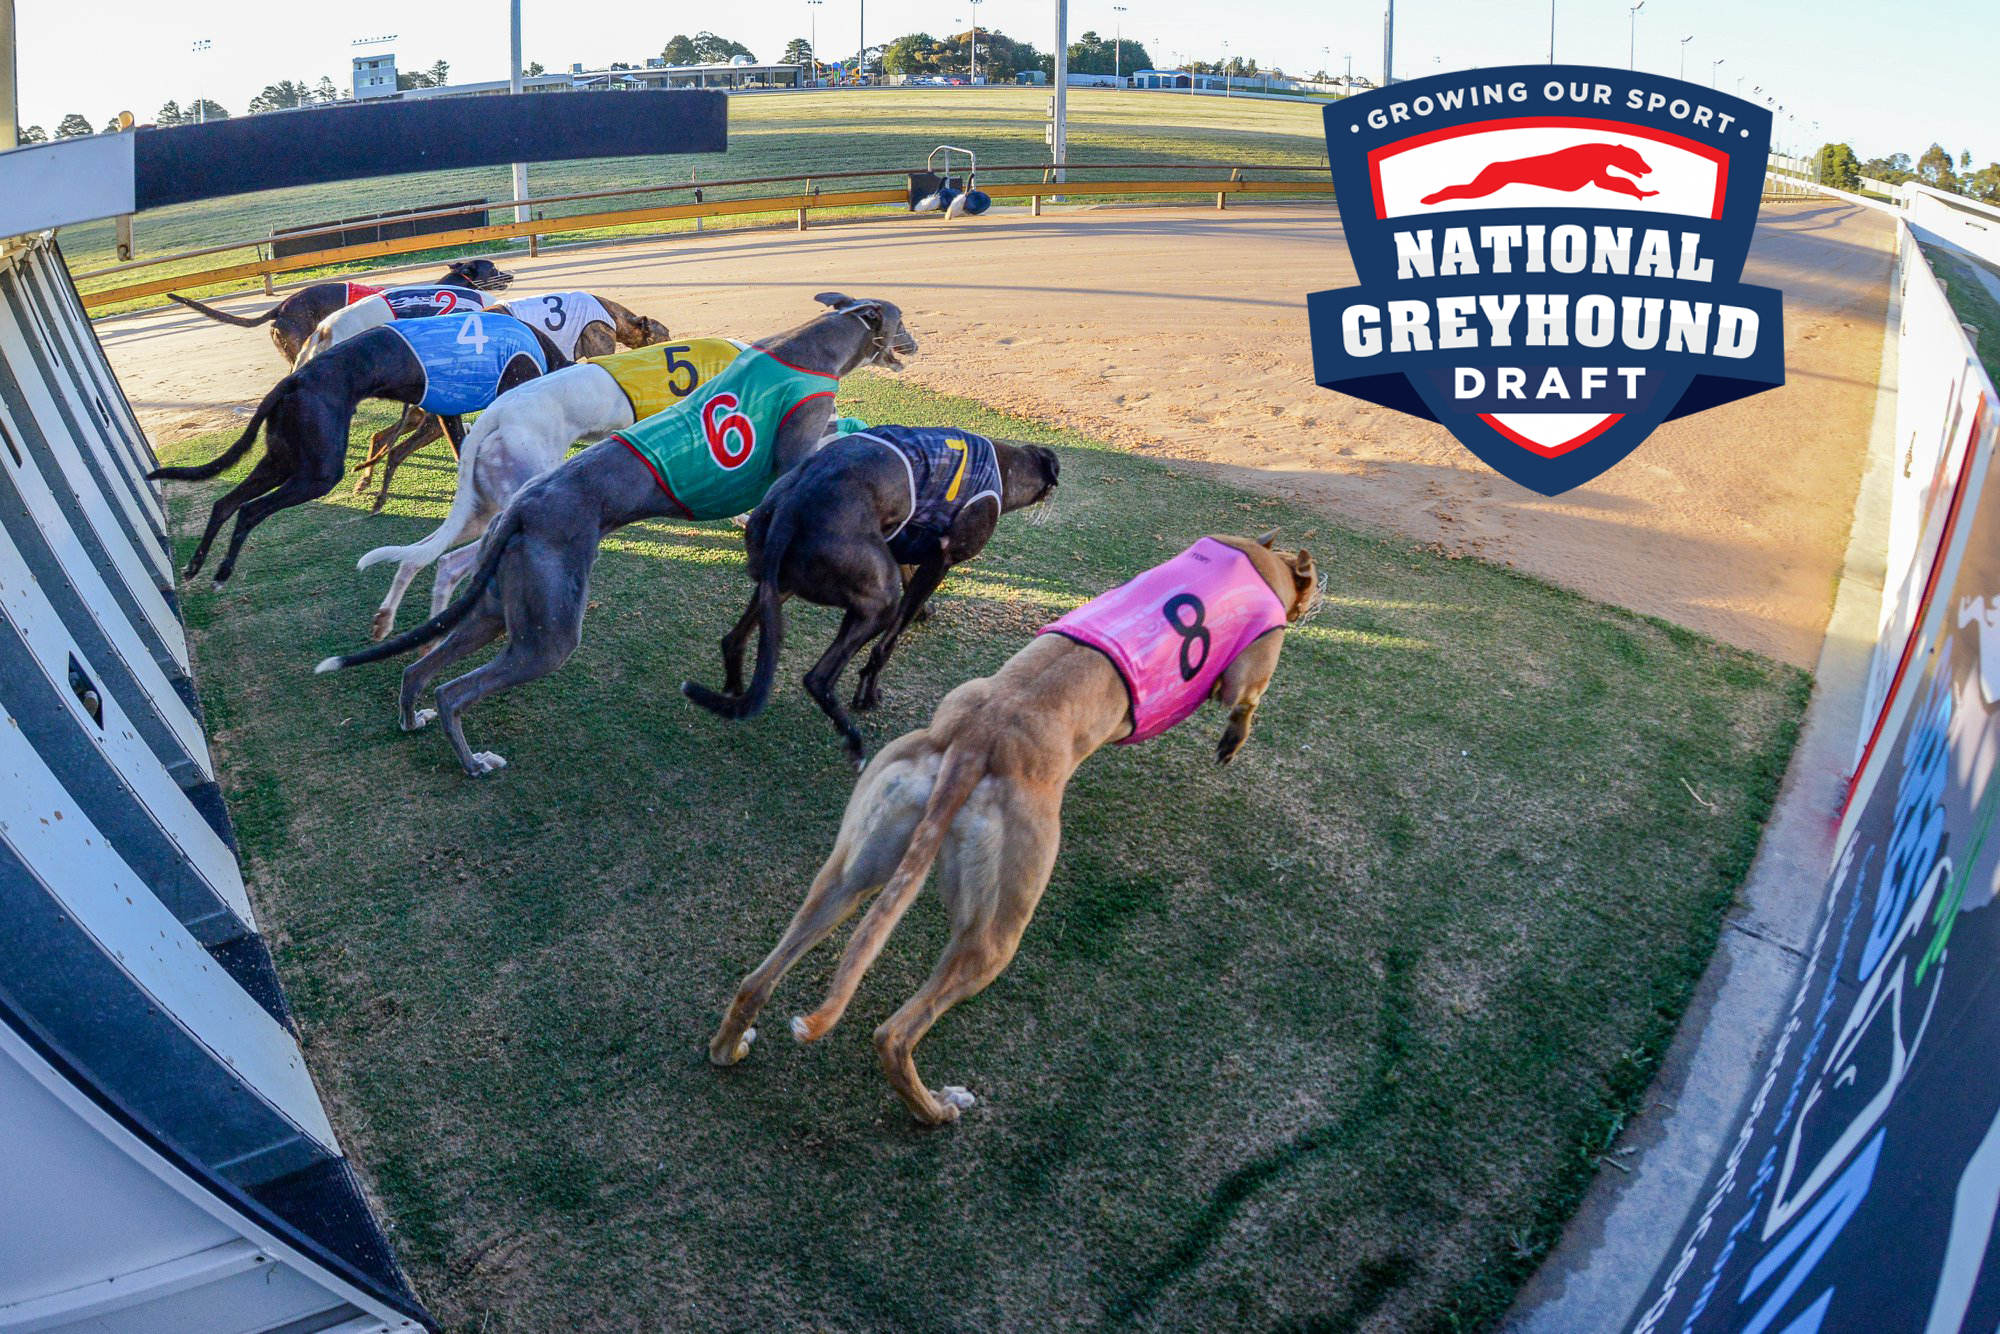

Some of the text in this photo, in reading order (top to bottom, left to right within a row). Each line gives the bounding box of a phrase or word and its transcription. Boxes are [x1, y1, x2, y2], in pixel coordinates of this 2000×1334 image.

[434, 291, 458, 316] 2
[542, 296, 567, 331] 3
[456, 314, 489, 354] 4
[664, 346, 698, 397] 5
[701, 392, 756, 471] 6
[945, 438, 968, 502] 7
[1163, 593, 1211, 682] 8
